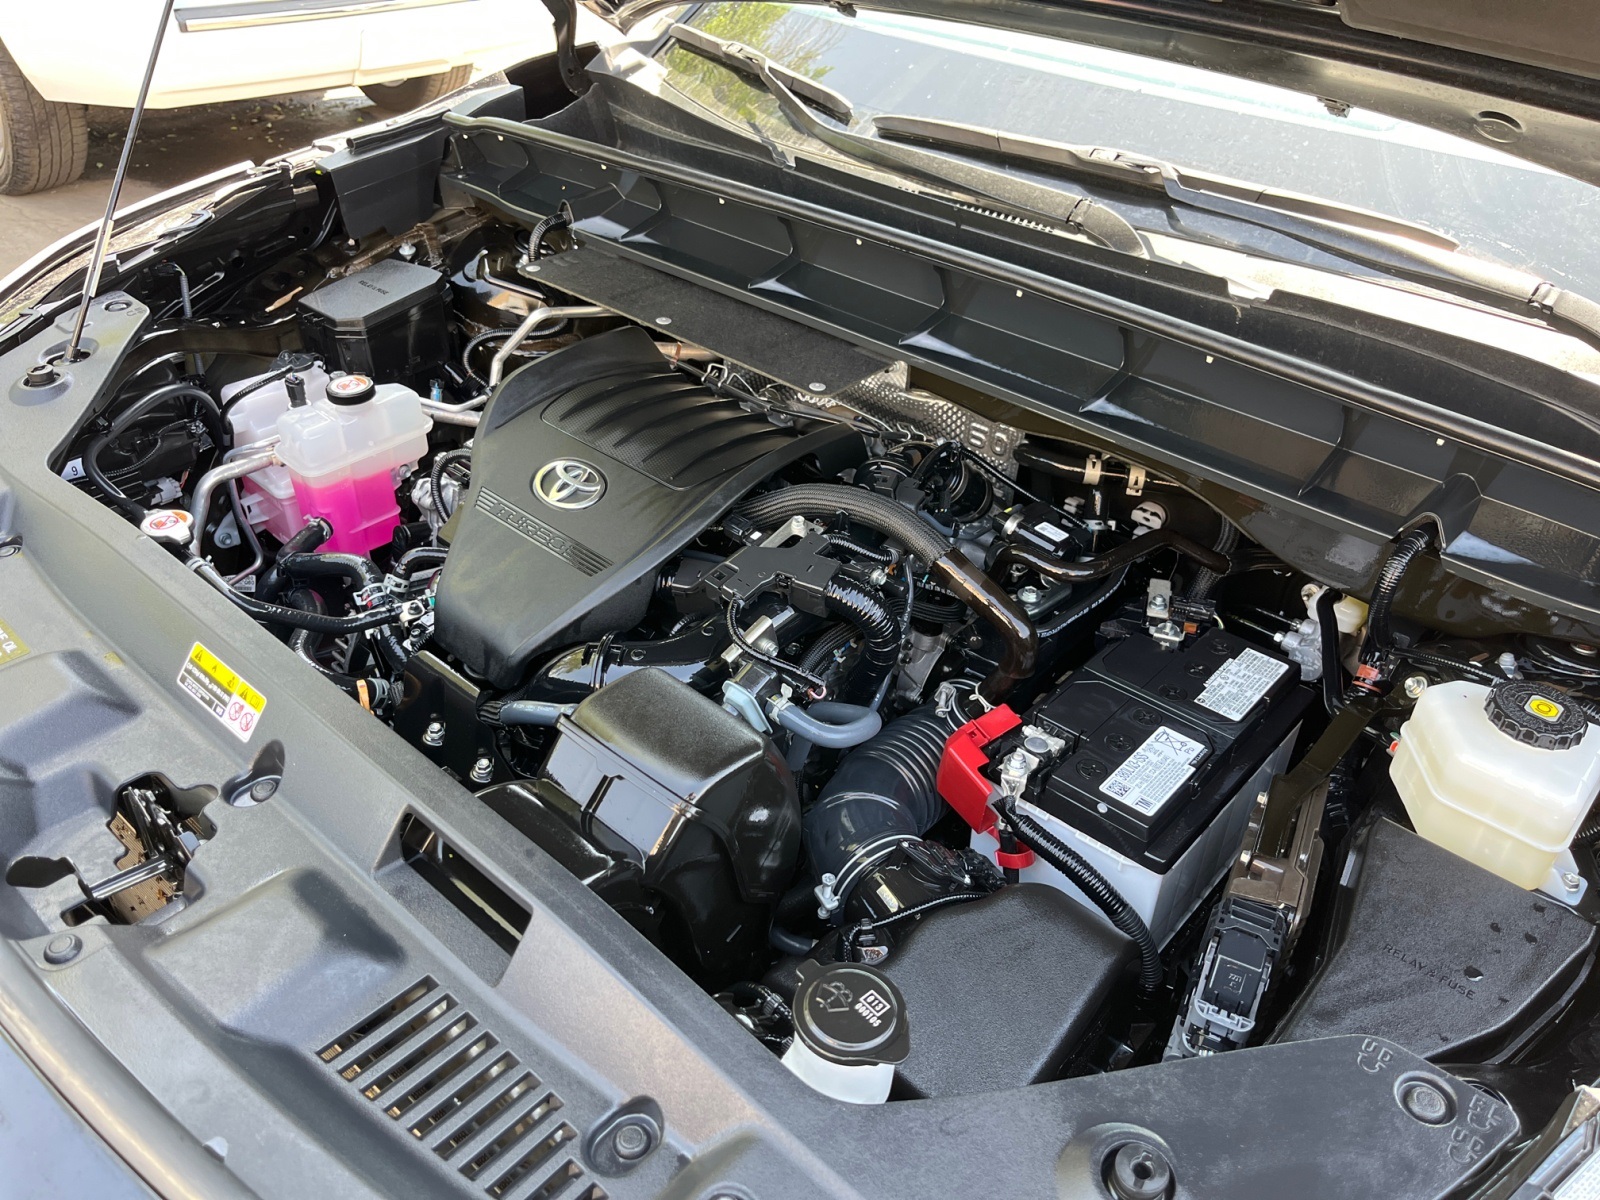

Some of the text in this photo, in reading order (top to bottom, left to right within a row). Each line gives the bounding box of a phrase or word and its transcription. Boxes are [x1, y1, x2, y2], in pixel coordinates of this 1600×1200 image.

[71, 465, 78, 476] 9
[497, 502, 566, 551] TURBO
[1383, 943, 1427, 971] RELAY
[1439, 975, 1476, 1000] FUSE
[855, 1002, 882, 1027] 000105
[866, 995, 884, 1011] 013
